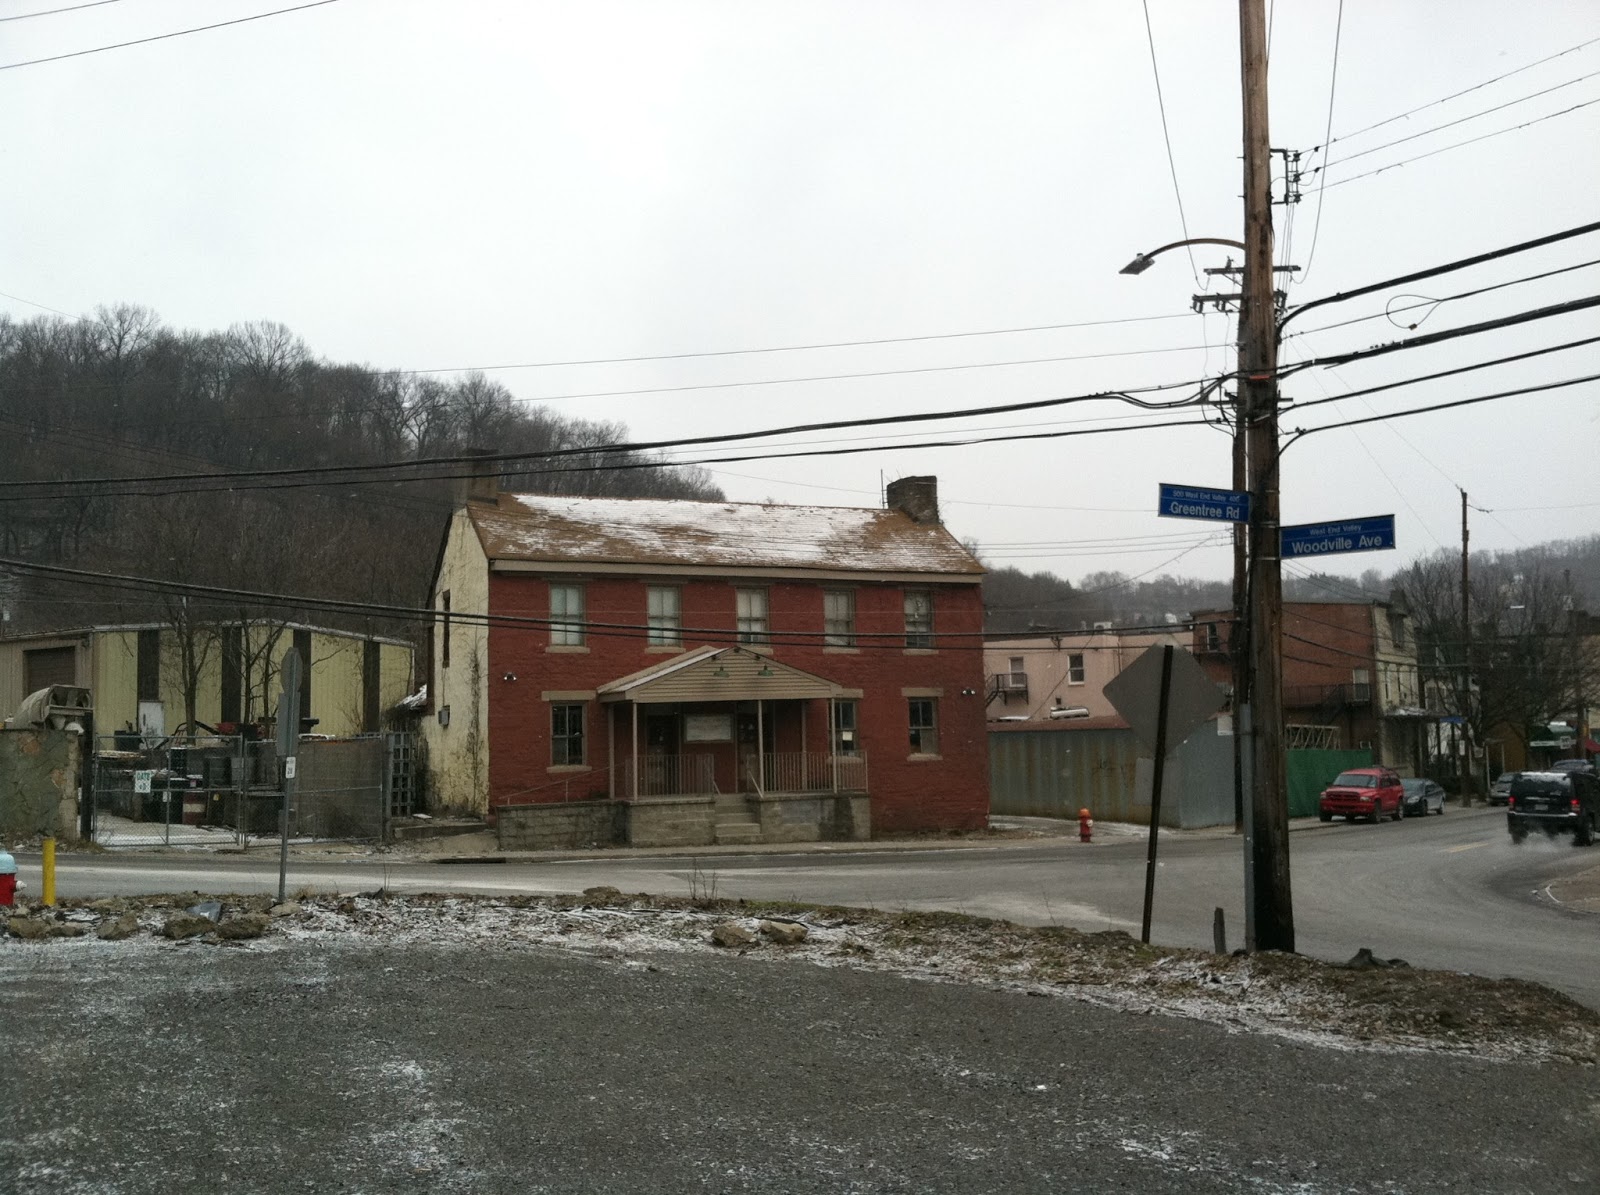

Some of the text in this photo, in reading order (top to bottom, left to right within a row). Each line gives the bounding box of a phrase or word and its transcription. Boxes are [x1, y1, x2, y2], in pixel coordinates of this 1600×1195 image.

[1185, 491, 1199, 499] West
[1212, 494, 1227, 502] Valley
[1170, 501, 1240, 519] Greentree Rd
[1310, 524, 1362, 535] West End Valley
[1291, 534, 1382, 554] Woodville Ave
